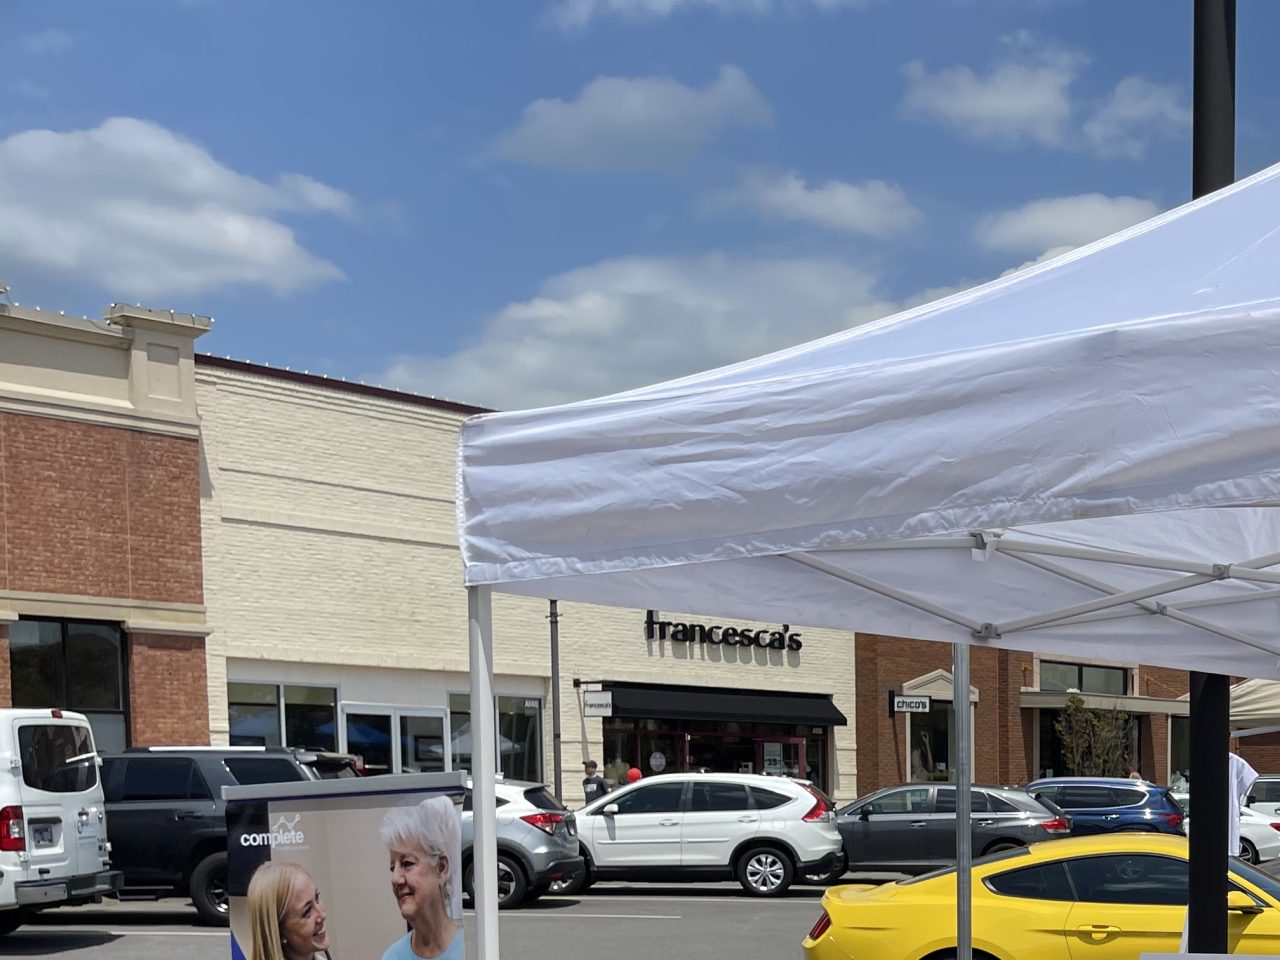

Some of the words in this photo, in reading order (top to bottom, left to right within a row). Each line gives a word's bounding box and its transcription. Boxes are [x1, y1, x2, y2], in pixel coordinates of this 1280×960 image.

[645, 609, 802, 651] francesca's
[896, 700, 927, 709] chico's
[240, 829, 304, 848] complete
